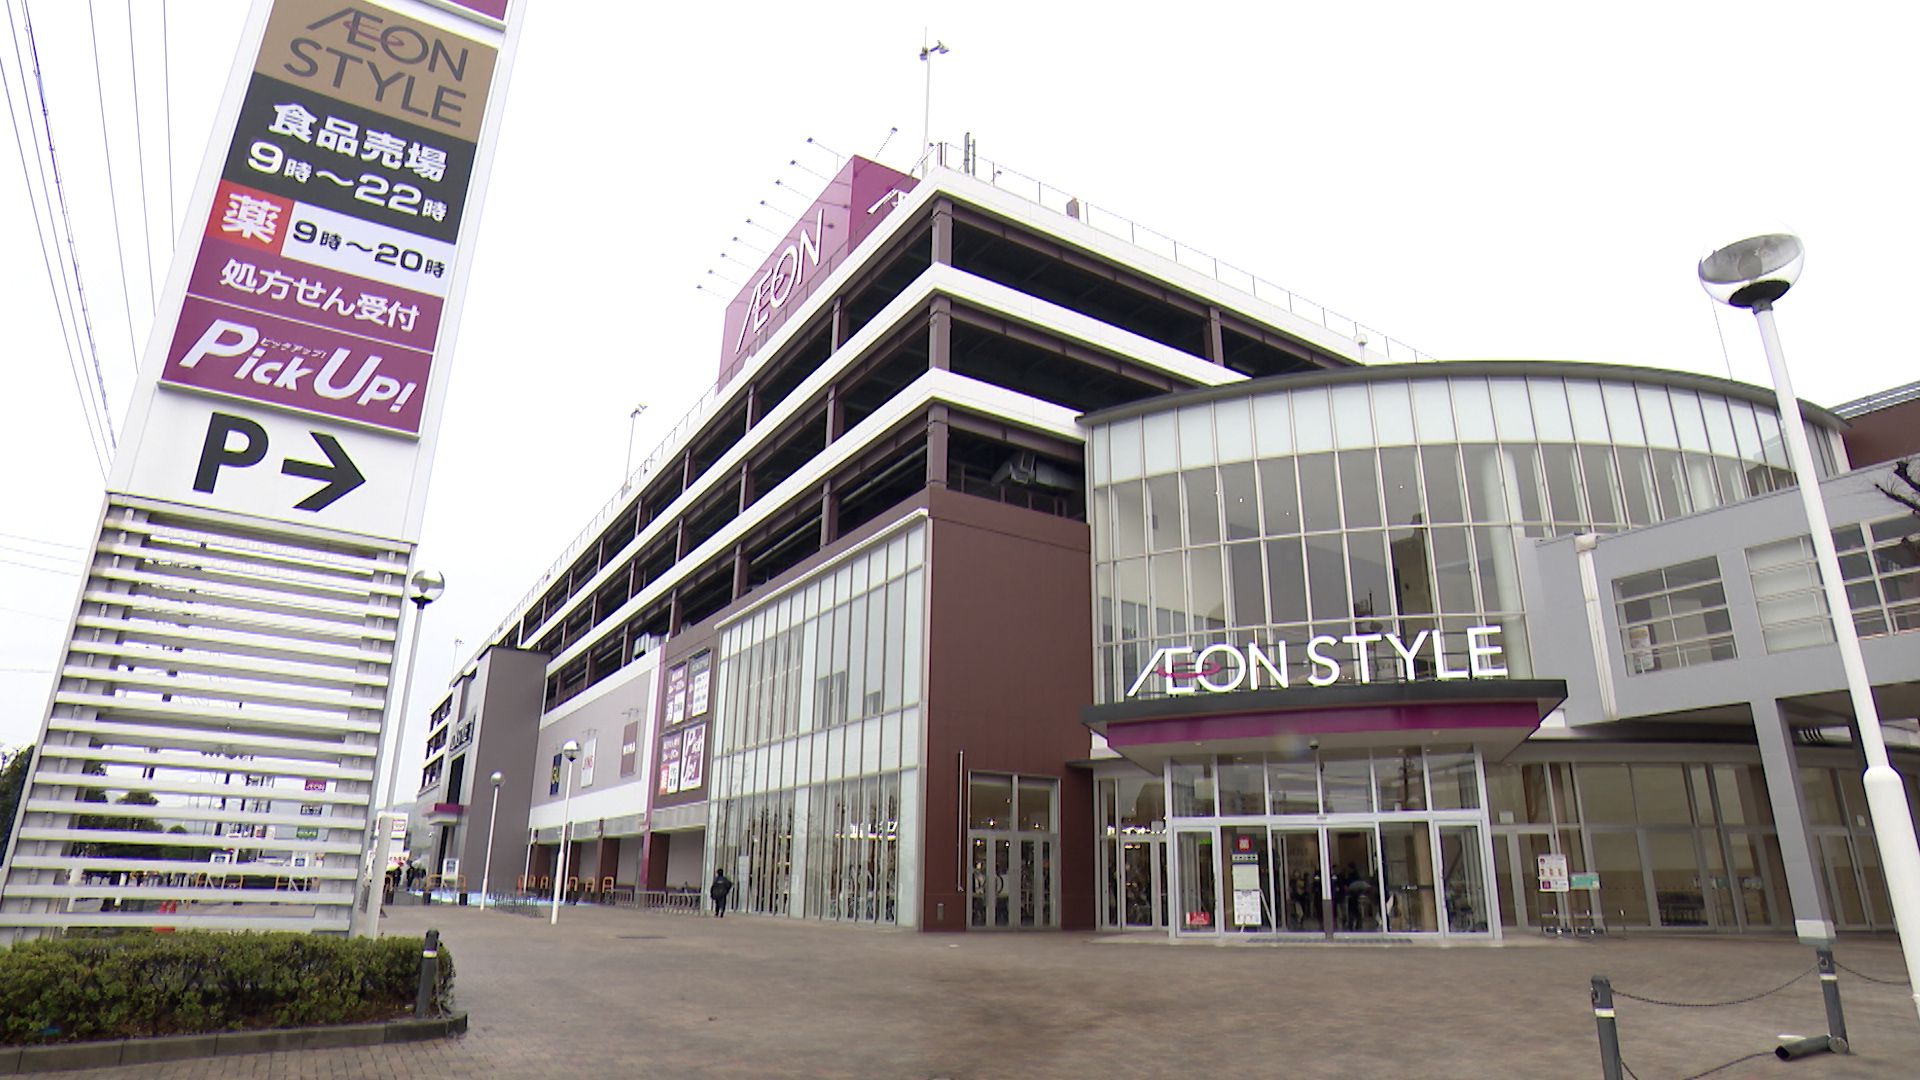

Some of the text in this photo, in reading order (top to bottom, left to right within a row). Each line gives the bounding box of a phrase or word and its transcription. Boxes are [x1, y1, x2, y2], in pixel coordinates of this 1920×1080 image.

[283, 37, 467, 128] STYLE
[268, 103, 449, 183] 食品売場
[220, 192, 283, 244] 薬
[219, 258, 421, 332] 処方せん受付
[192, 411, 270, 495] P
[1306, 625, 1509, 688] STYLE
